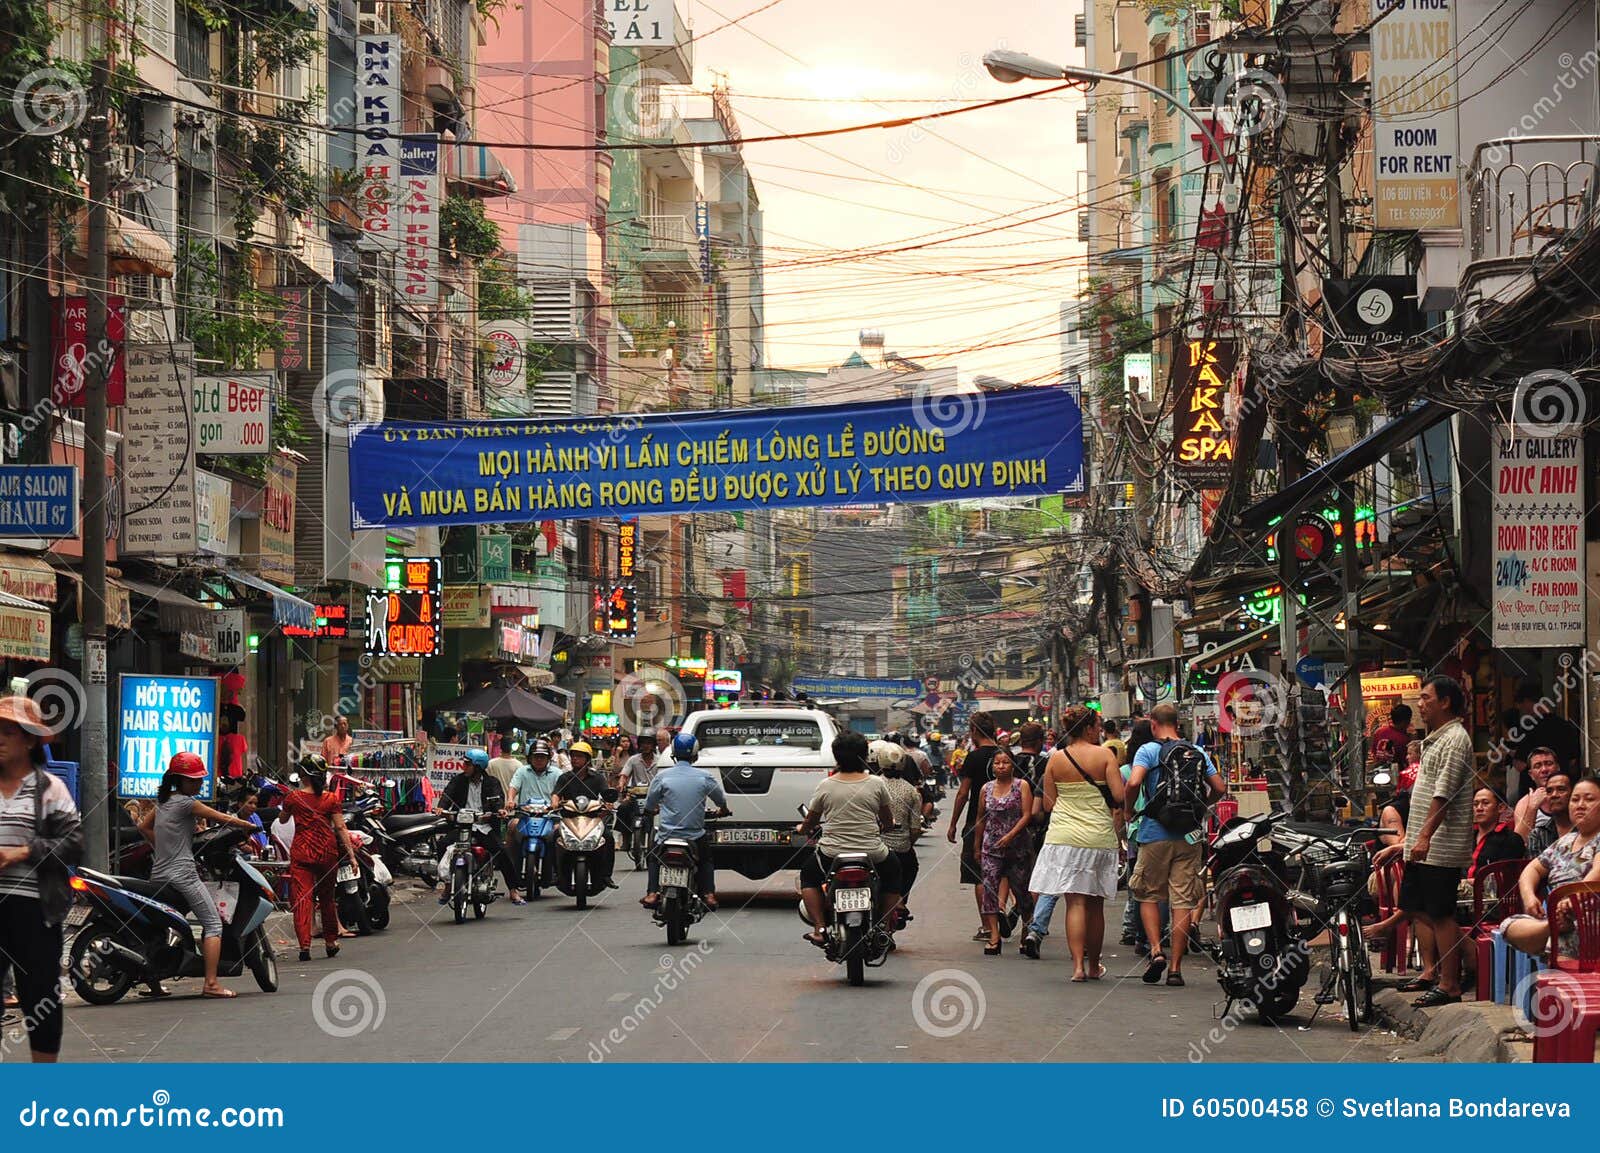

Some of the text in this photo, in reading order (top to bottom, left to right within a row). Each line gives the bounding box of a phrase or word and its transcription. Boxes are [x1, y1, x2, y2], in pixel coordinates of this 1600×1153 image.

[605, 0, 650, 11] EL
[1379, 21, 1449, 60] THANH
[1378, 74, 1451, 122] QUANG
[1394, 128, 1437, 147] ROOM
[400, 147, 437, 161] Gallery
[1380, 155, 1452, 174] FOR RENT
[228, 381, 264, 413] Beer
[1189, 341, 1224, 432] KAKA
[416, 427, 457, 441] BAN
[478, 422, 945, 480] MỌI HÀNH VI LẤN CHIẾM LÒNG LỀ ĐƯỜNG
[1180, 437, 1233, 460] SPA
[1499, 438, 1578, 459] ART GALLERY
[25, 475, 67, 497] SALON
[383, 458, 1047, 517] VÀ MUA BÁN HÀNG RONG ĐỀU ĐƯỢC XỬ LÝ THEO QUY ĐỊNH
[1540, 465, 1578, 494] ANH
[51, 506, 67, 526] 87
[619, 525, 635, 577] HOTEL
[1498, 525, 1579, 551] ROOM FOR RENT
[1496, 557, 1577, 587] 24/24 A/C ROOM
[1532, 582, 1578, 597] FAN ROOM
[217, 624, 241, 653] HẤP
[388, 625, 435, 653] CLINIC
[135, 679, 202, 708] HỚT TÓC
[1390, 681, 1419, 691] KEBAB
[123, 709, 213, 733] HAIR SALON
